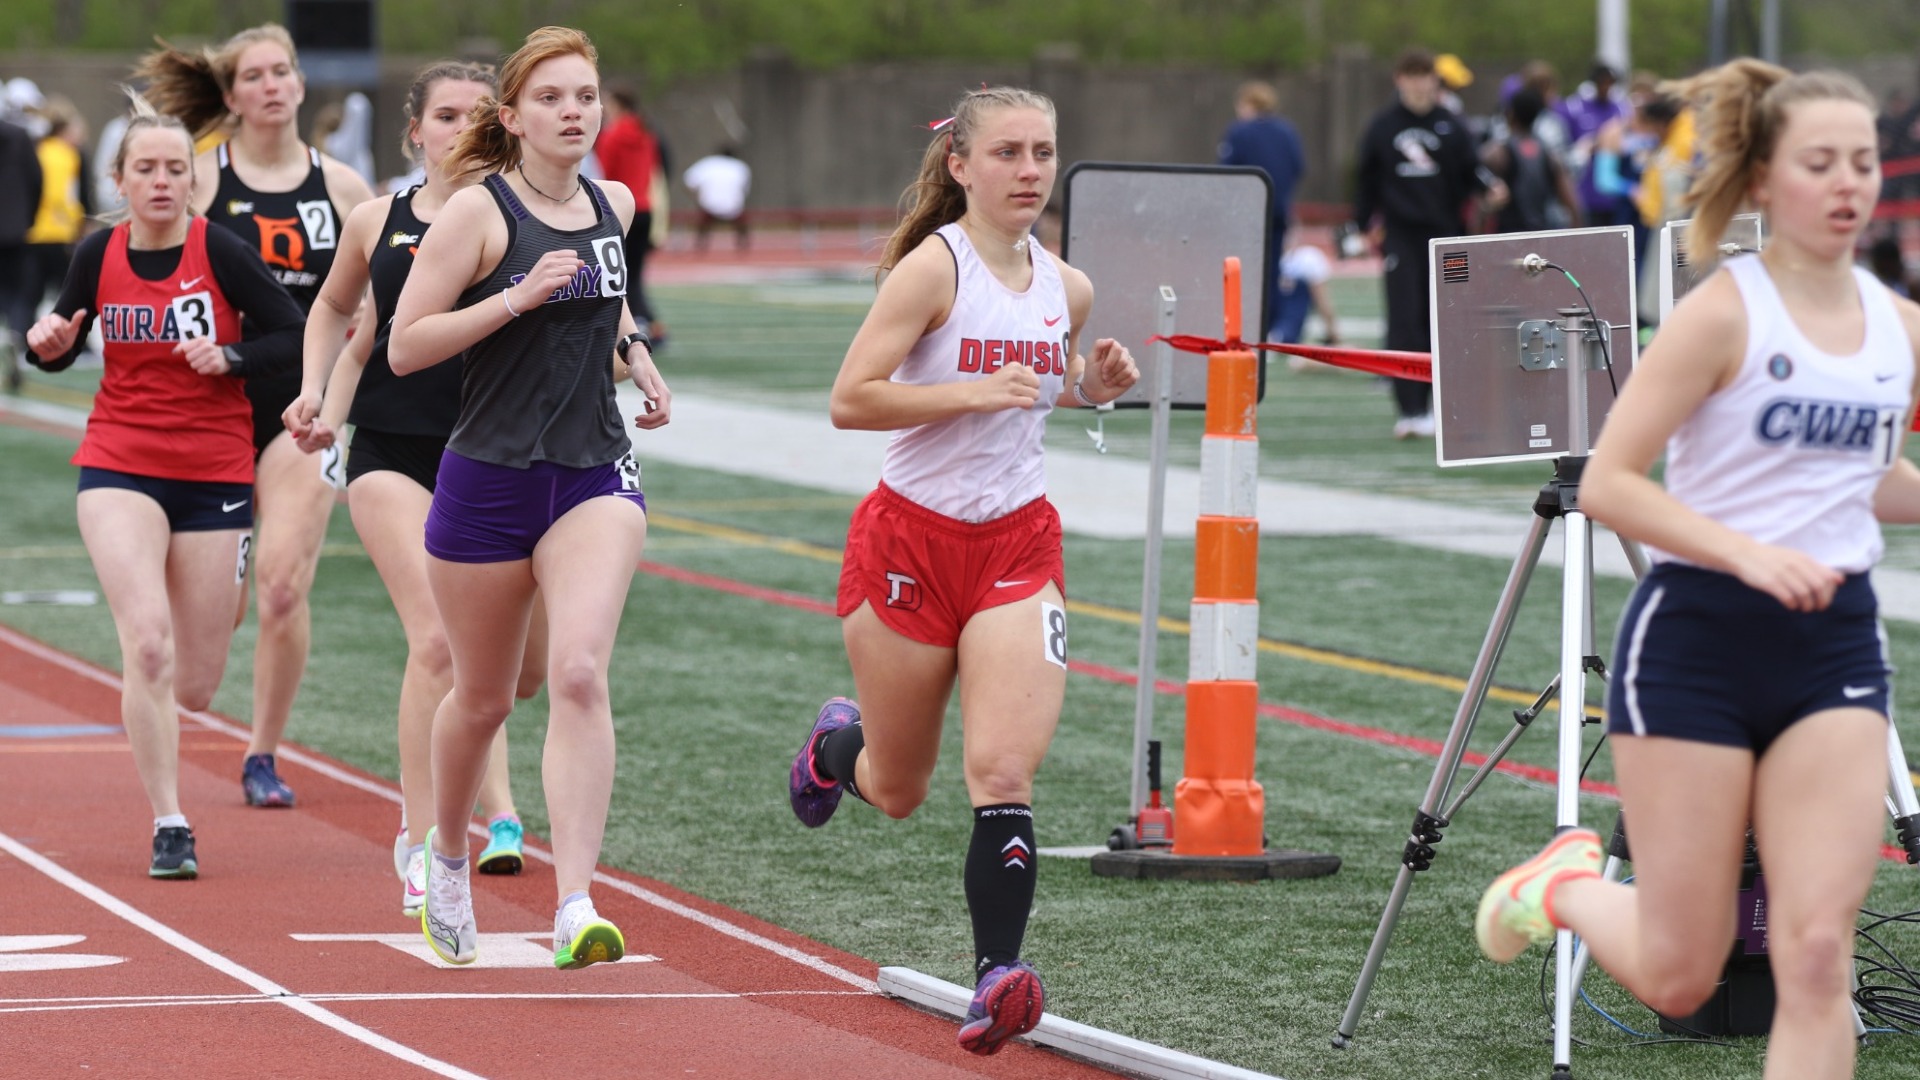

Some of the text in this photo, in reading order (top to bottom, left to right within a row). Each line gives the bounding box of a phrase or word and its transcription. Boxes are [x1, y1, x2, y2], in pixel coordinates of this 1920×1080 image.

[307, 207, 331, 243] 2
[601, 240, 625, 292] 9
[103, 303, 180, 343] HIRA
[181, 298, 210, 340] 3
[957, 337, 1065, 376] DENISO
[1756, 397, 1877, 451] CWR
[1882, 412, 1896, 466] 1
[325, 444, 339, 482] 2
[238, 535, 252, 580] 3
[886, 570, 922, 613] D
[1048, 609, 1067, 665] 8
